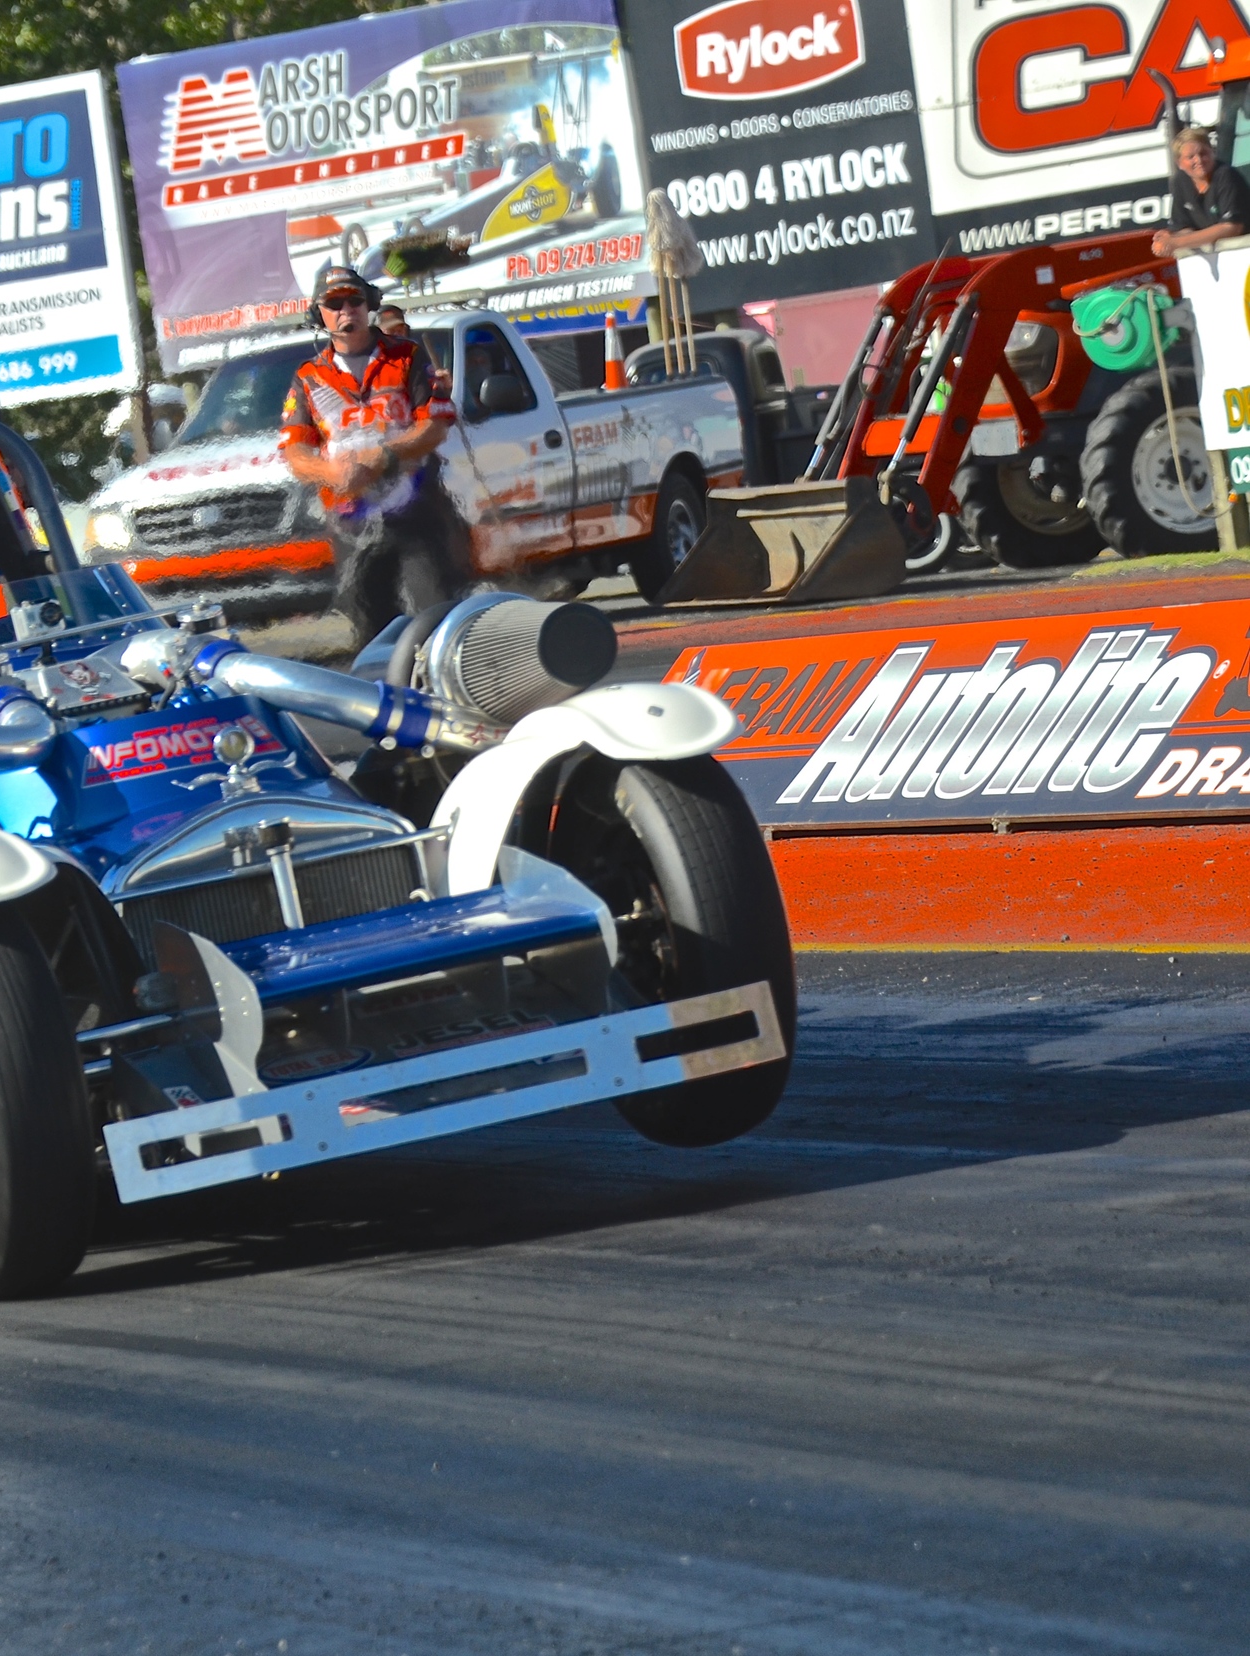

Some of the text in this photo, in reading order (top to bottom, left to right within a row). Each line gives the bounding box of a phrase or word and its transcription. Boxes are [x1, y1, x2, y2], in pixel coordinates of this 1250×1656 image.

[695, 12, 845, 84] Rylock
[651, 90, 914, 154] WINDOWS DOORS CONSERVATORIES
[172, 137, 458, 204] RACE ENGINES
[667, 142, 911, 218] 0800 4 RYLOCK
[506, 234, 642, 281] Ph. 09 274 7997
[698, 208, 916, 270] ww.rylock.co.nz
[487, 292, 526, 314] FLOW
[526, 284, 577, 308] BENCH
[574, 274, 636, 300] TESTING
[39, 350, 78, 375] 999
[571, 420, 620, 450] FRAM
[718, 655, 876, 740] FRAM
[776, 628, 1212, 804] Autolite
[387, 1008, 548, 1051] JESEL
